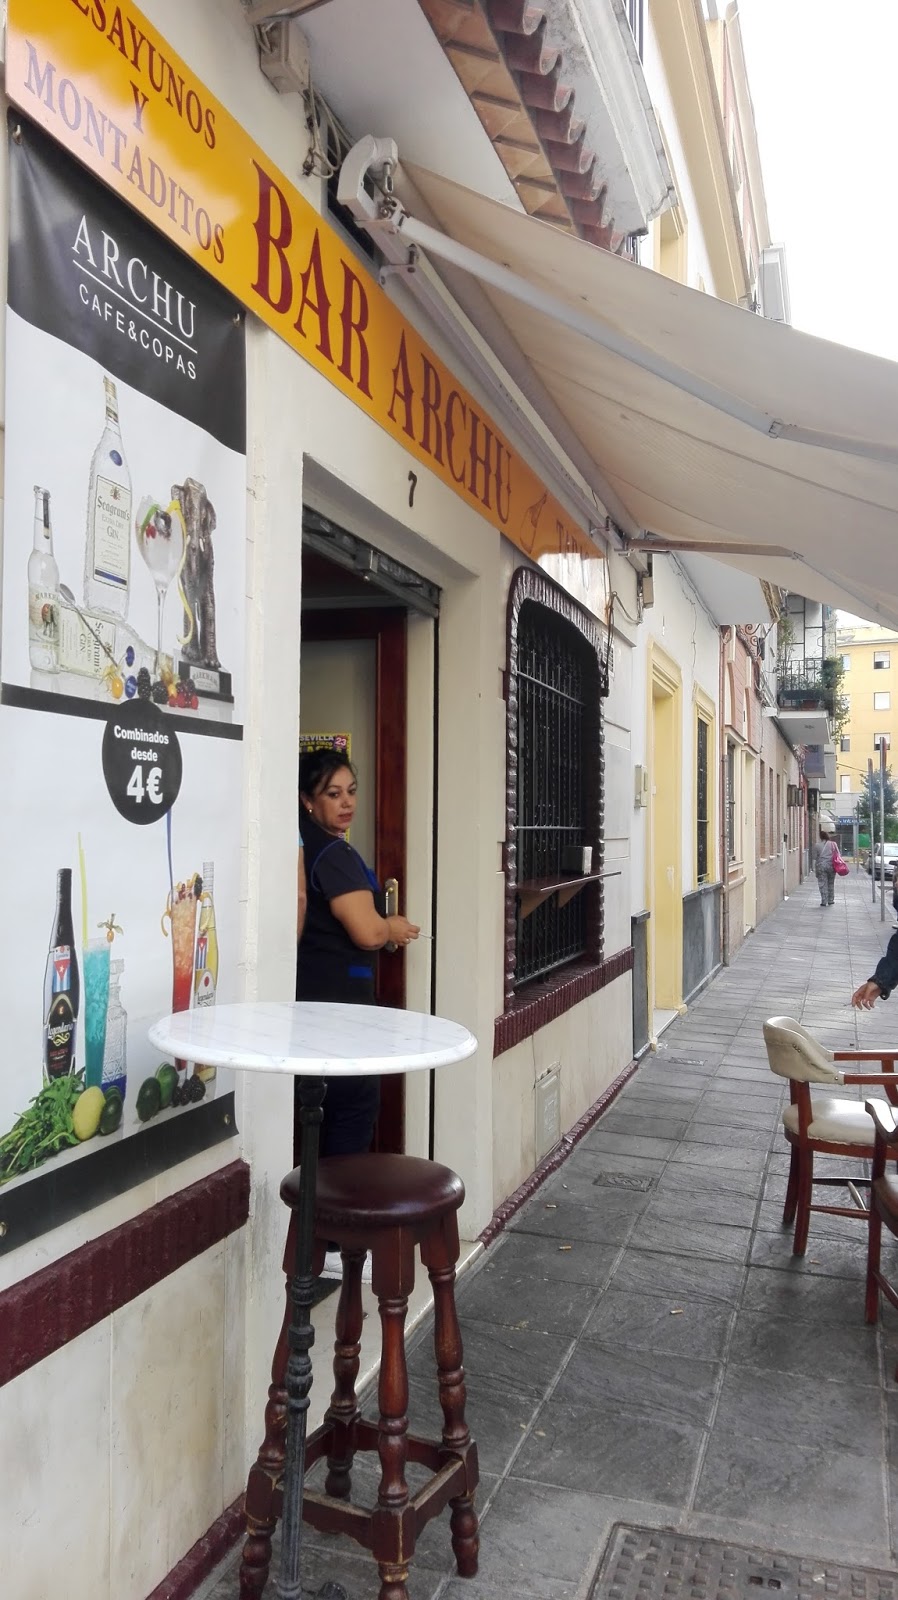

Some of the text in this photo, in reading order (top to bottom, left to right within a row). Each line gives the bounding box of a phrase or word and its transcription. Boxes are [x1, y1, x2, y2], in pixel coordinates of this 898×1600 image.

[129, 80, 150, 134] Y
[24, 39, 225, 264] MONTADITOS
[72, 215, 197, 338] ARCHU
[79, 284, 197, 380] CAFE&COPAS
[250, 157, 512, 525] BAR ARCHU
[407, 470, 418, 508] 7
[114, 725, 169, 744] Combinados
[131, 747, 158, 762] desde
[335, 737, 347, 746] 23
[127, 765, 163, 804] 4€
